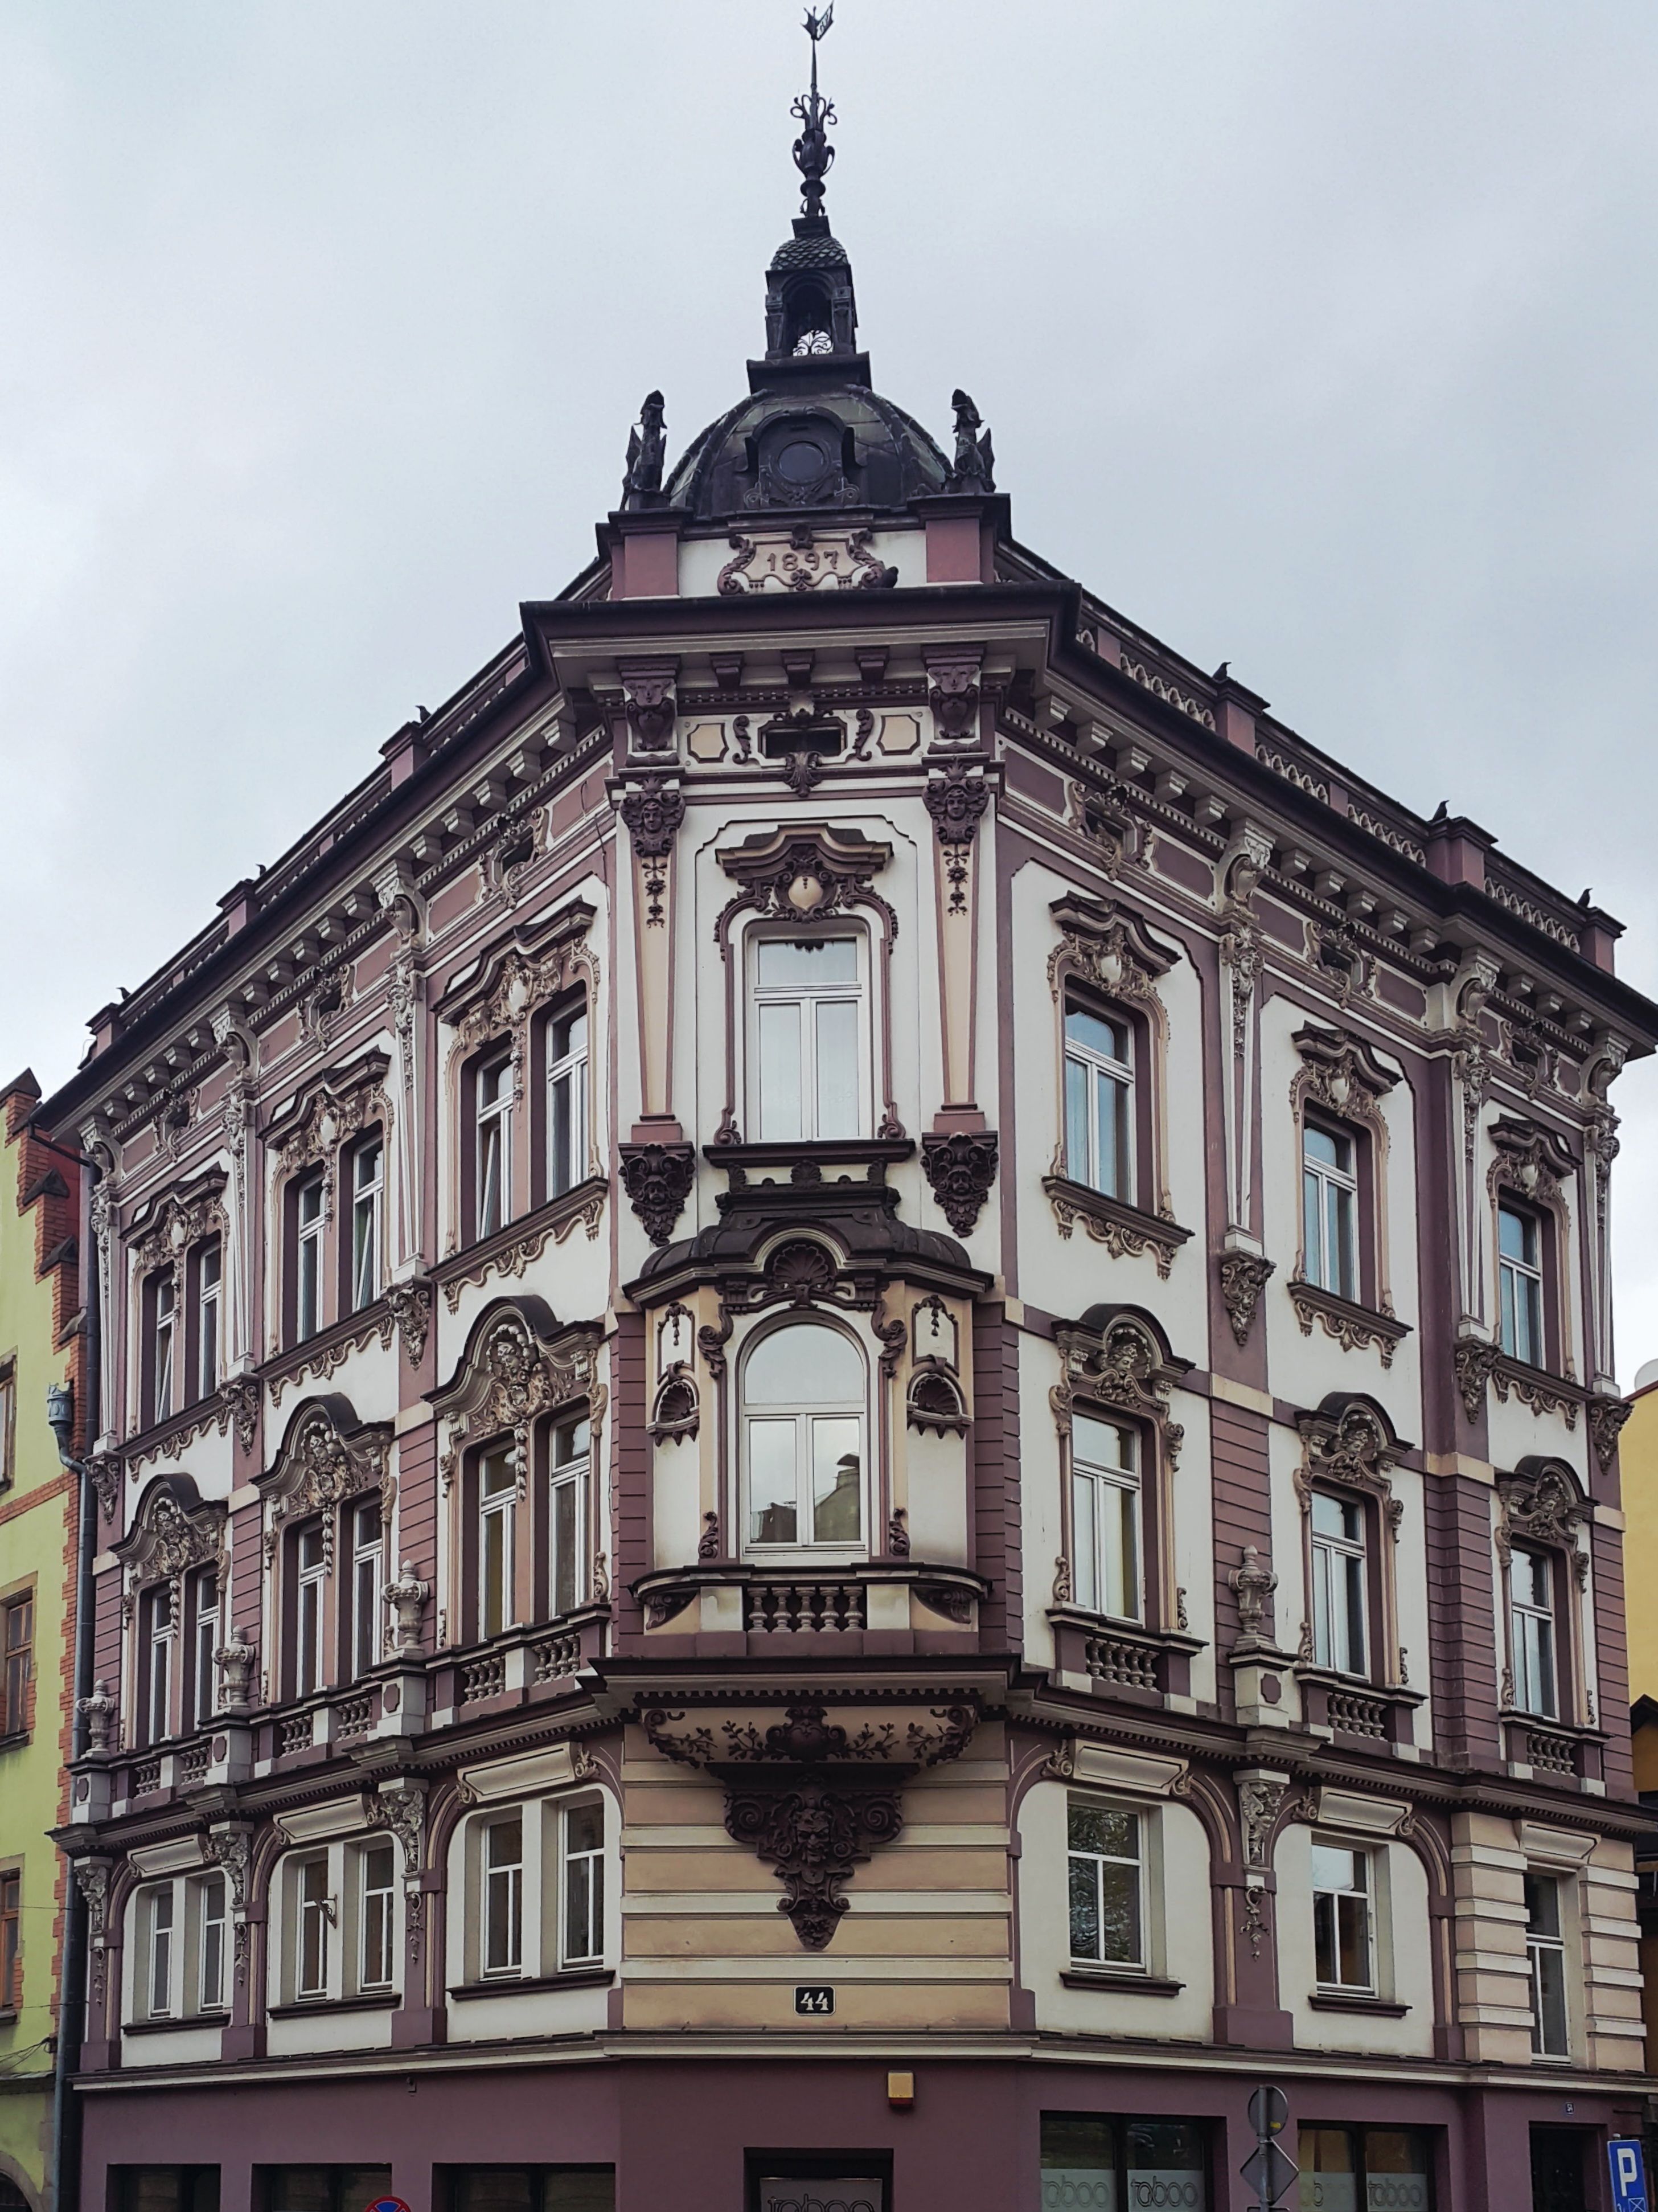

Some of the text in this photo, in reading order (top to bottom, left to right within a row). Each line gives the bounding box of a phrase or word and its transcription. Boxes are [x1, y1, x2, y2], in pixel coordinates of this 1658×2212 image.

[767, 550, 838, 571] 1897
[800, 1992, 829, 2010] 44
[1617, 2148, 1638, 2197] P
[1130, 2176, 1198, 2207] taboo
